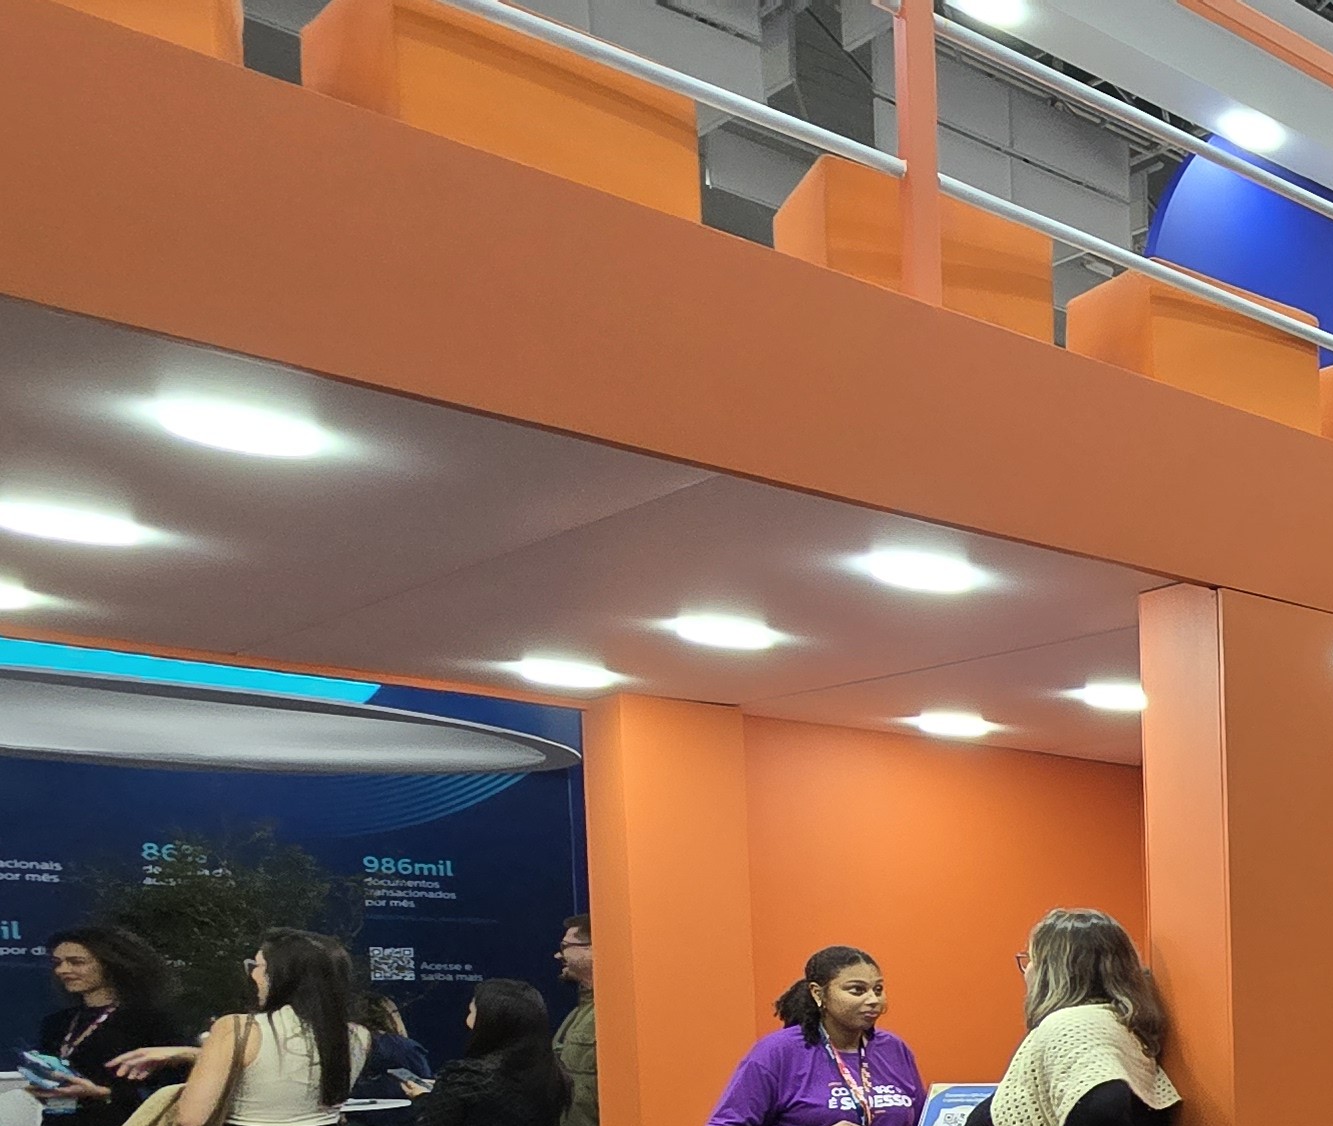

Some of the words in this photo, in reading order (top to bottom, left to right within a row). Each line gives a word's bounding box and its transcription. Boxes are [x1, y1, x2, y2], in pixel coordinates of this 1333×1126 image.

[363, 856, 454, 876] 986mil
[25, 872, 60, 883] mês
[365, 899, 386, 907] por
[390, 900, 415, 908] mês
[420, 962, 462, 971] Acesse
[455, 974, 483, 982] mais
[829, 1094, 838, 1109] É
[840, 1093, 912, 1110] SUESSO
